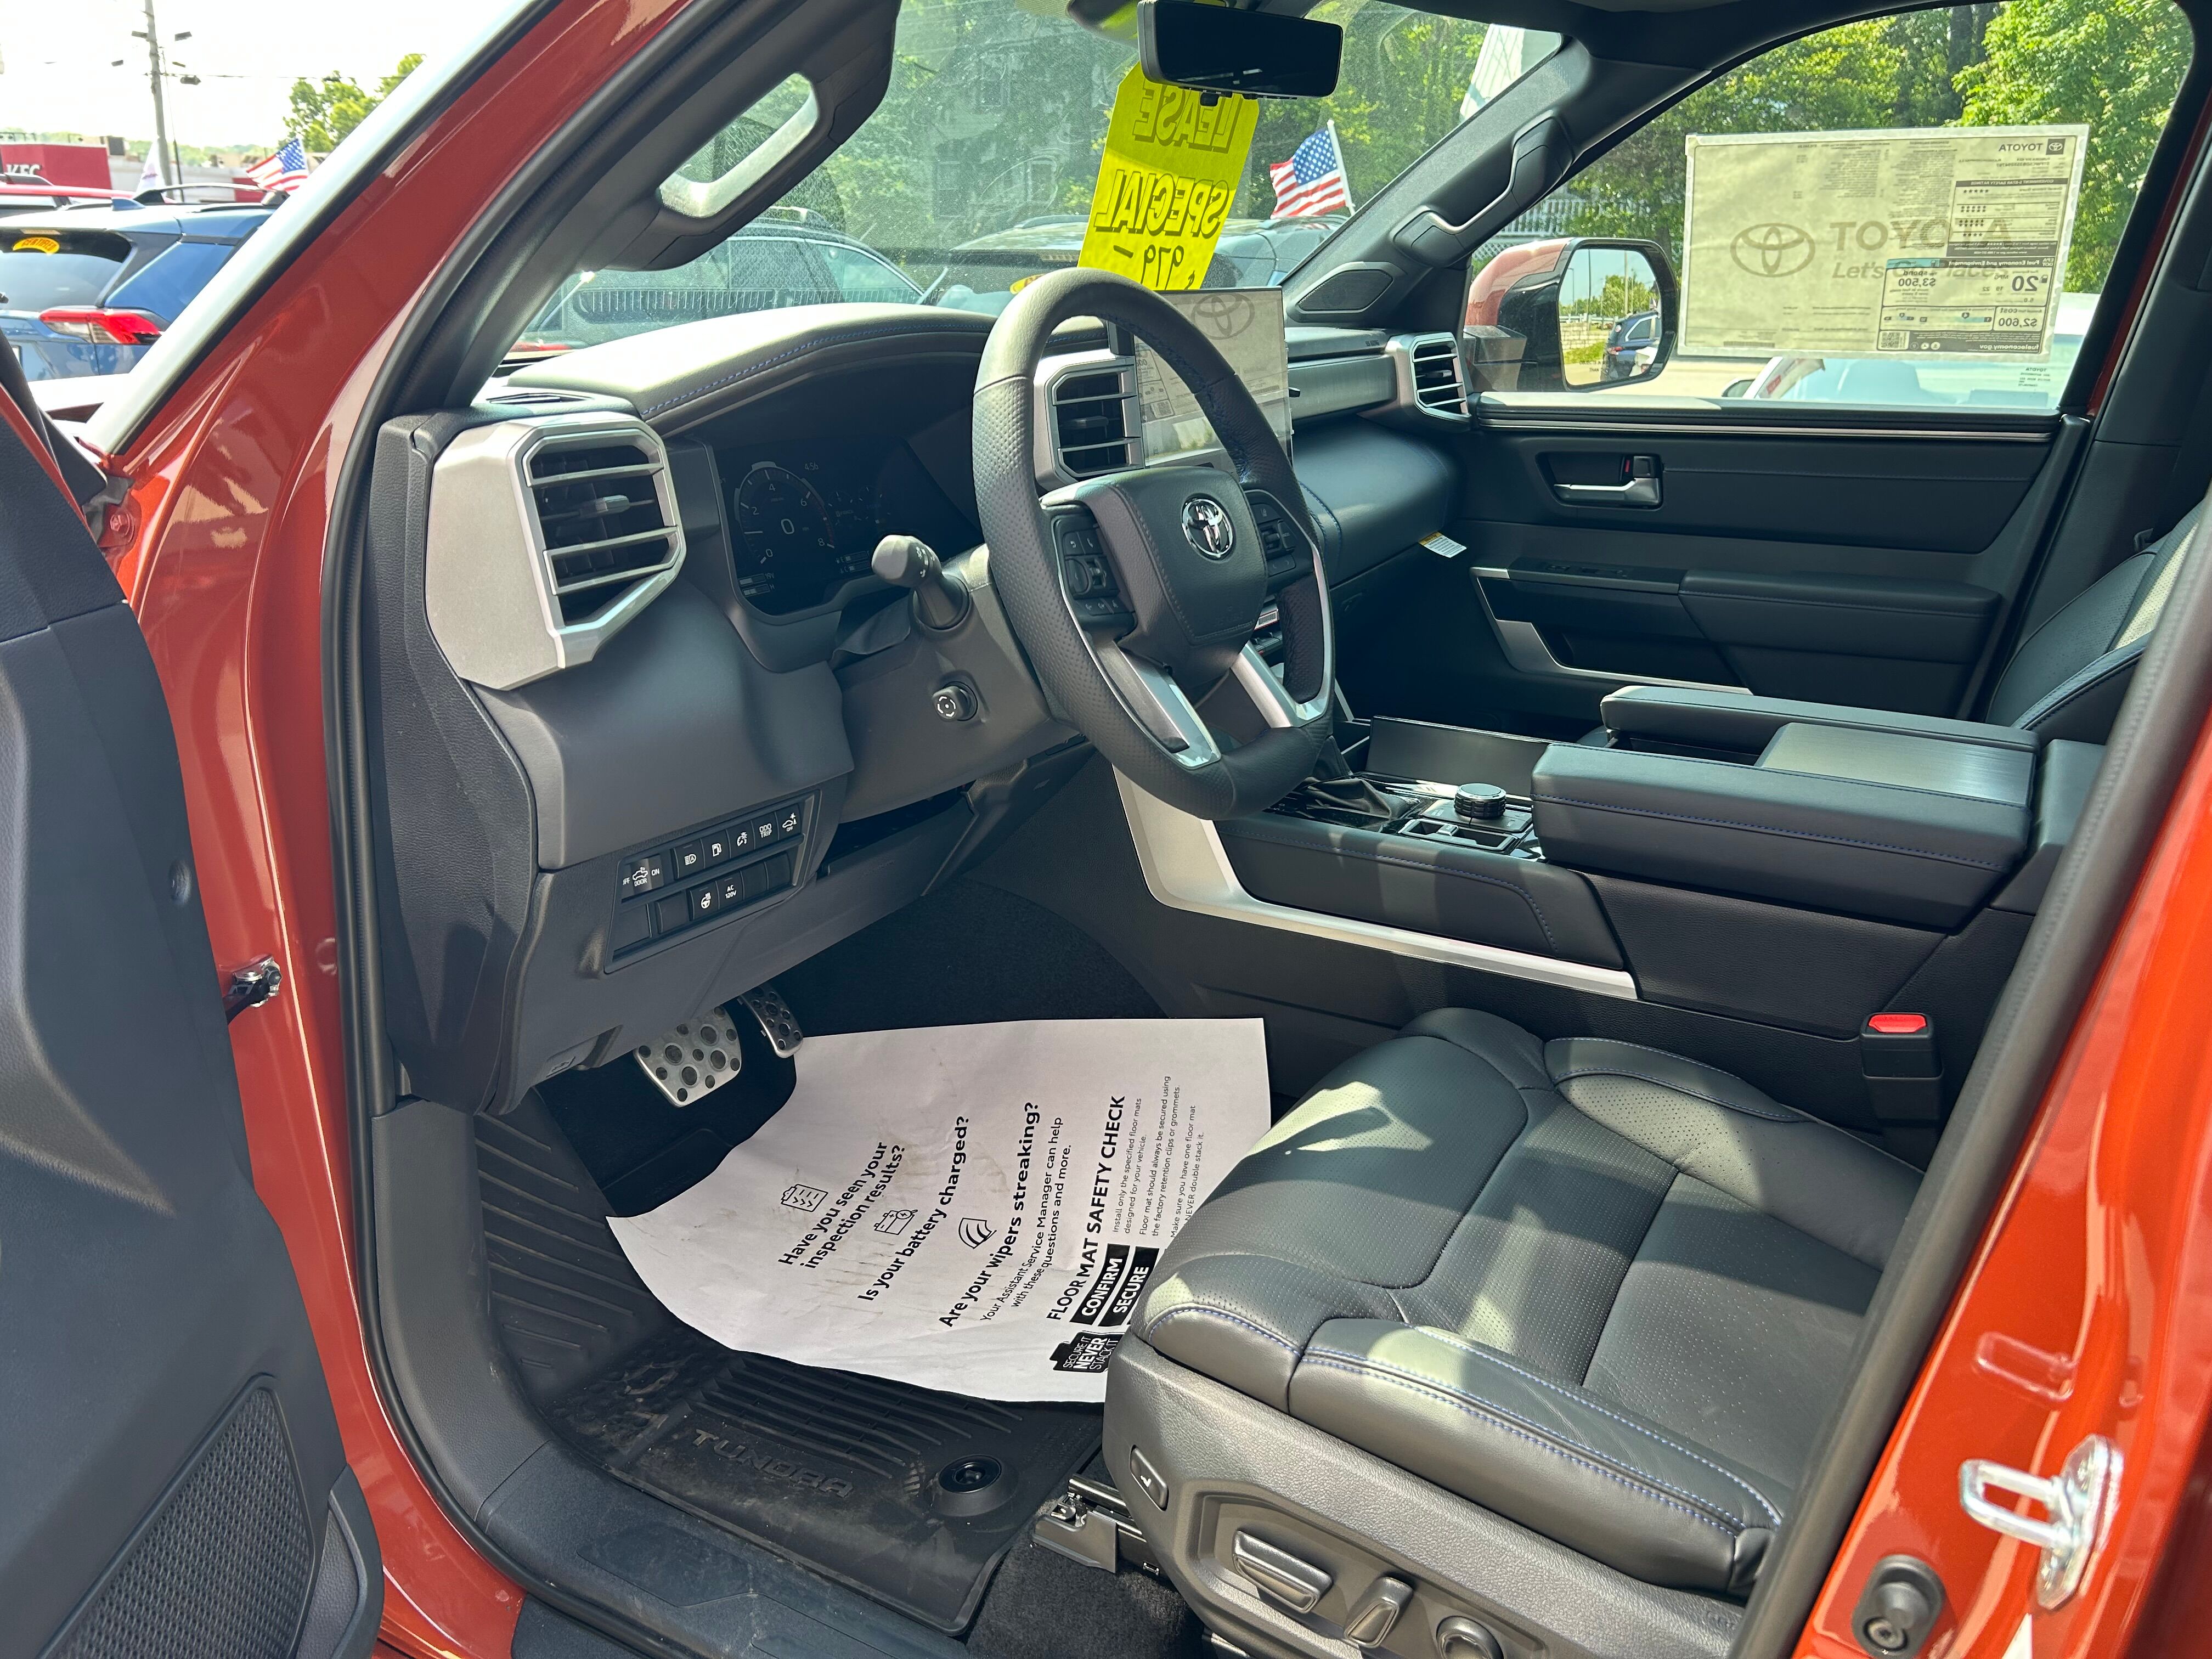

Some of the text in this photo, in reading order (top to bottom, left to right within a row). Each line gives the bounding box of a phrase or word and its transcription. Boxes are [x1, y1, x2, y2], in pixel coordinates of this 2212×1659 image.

[6, 163, 40, 174] KFC
[1829, 220, 2011, 251] TOYOTA
[1832, 262, 1884, 279] Let's
[769, 483, 776, 492] 4
[752, 507, 759, 515] 2
[780, 518, 795, 534] 0
[766, 549, 774, 557] 0
[817, 538, 825, 546] 8
[759, 823, 772, 832] ODO
[651, 868, 660, 876] ON
[725, 890, 737, 899] 120V
[727, 884, 735, 893] AC
[1129, 1119, 1137, 1138] floor
[1155, 1131, 1163, 1141] be
[1170, 1127, 1175, 1136] or
[1125, 1139, 1135, 1173] specified
[1153, 1143, 1162, 1168] always
[1165, 1137, 1174, 1156] clips
[1125, 1197, 1136, 1233] designed
[1138, 1135, 1147, 1164] vehicle.
[1147, 1169, 1156, 1197] should
[1160, 1157, 1171, 1193] retention
[1171, 1216, 1180, 1238] Make
[1180, 1161, 1189, 1180] have
[1186, 1122, 1194, 1142] floor
[778, 1142, 887, 1265] Have you seen your
[1119, 1189, 1127, 1207] only
[1185, 1194, 1195, 1220] NEVER
[1190, 1163, 1200, 1192] double
[800, 1145, 905, 1268] inspection results?
[858, 1116, 969, 1300] Is your battery charged?
[939, 1103, 1040, 1327] Are your wipers streaking?
[980, 1118, 1062, 1321] Your Assistant Service Manager can help
[1046, 1096, 1125, 1320] FLOOR MAT SAFETY CHECK
[1154, 1193, 1167, 1221] factory
[1012, 1145, 1071, 1307] with these questions and more.
[1113, 1209, 1122, 1233] Install
[1140, 1215, 1149, 1235] Floor
[1081, 1259, 1122, 1316] CONFIRM
[1113, 1267, 1149, 1313] SECURE
[1063, 1344, 1084, 1368] SECURE
[1073, 1338, 1107, 1369] NEVER
[1090, 1339, 1119, 1370] STACK IT
[692, 1428, 854, 1499] TUNDRA
